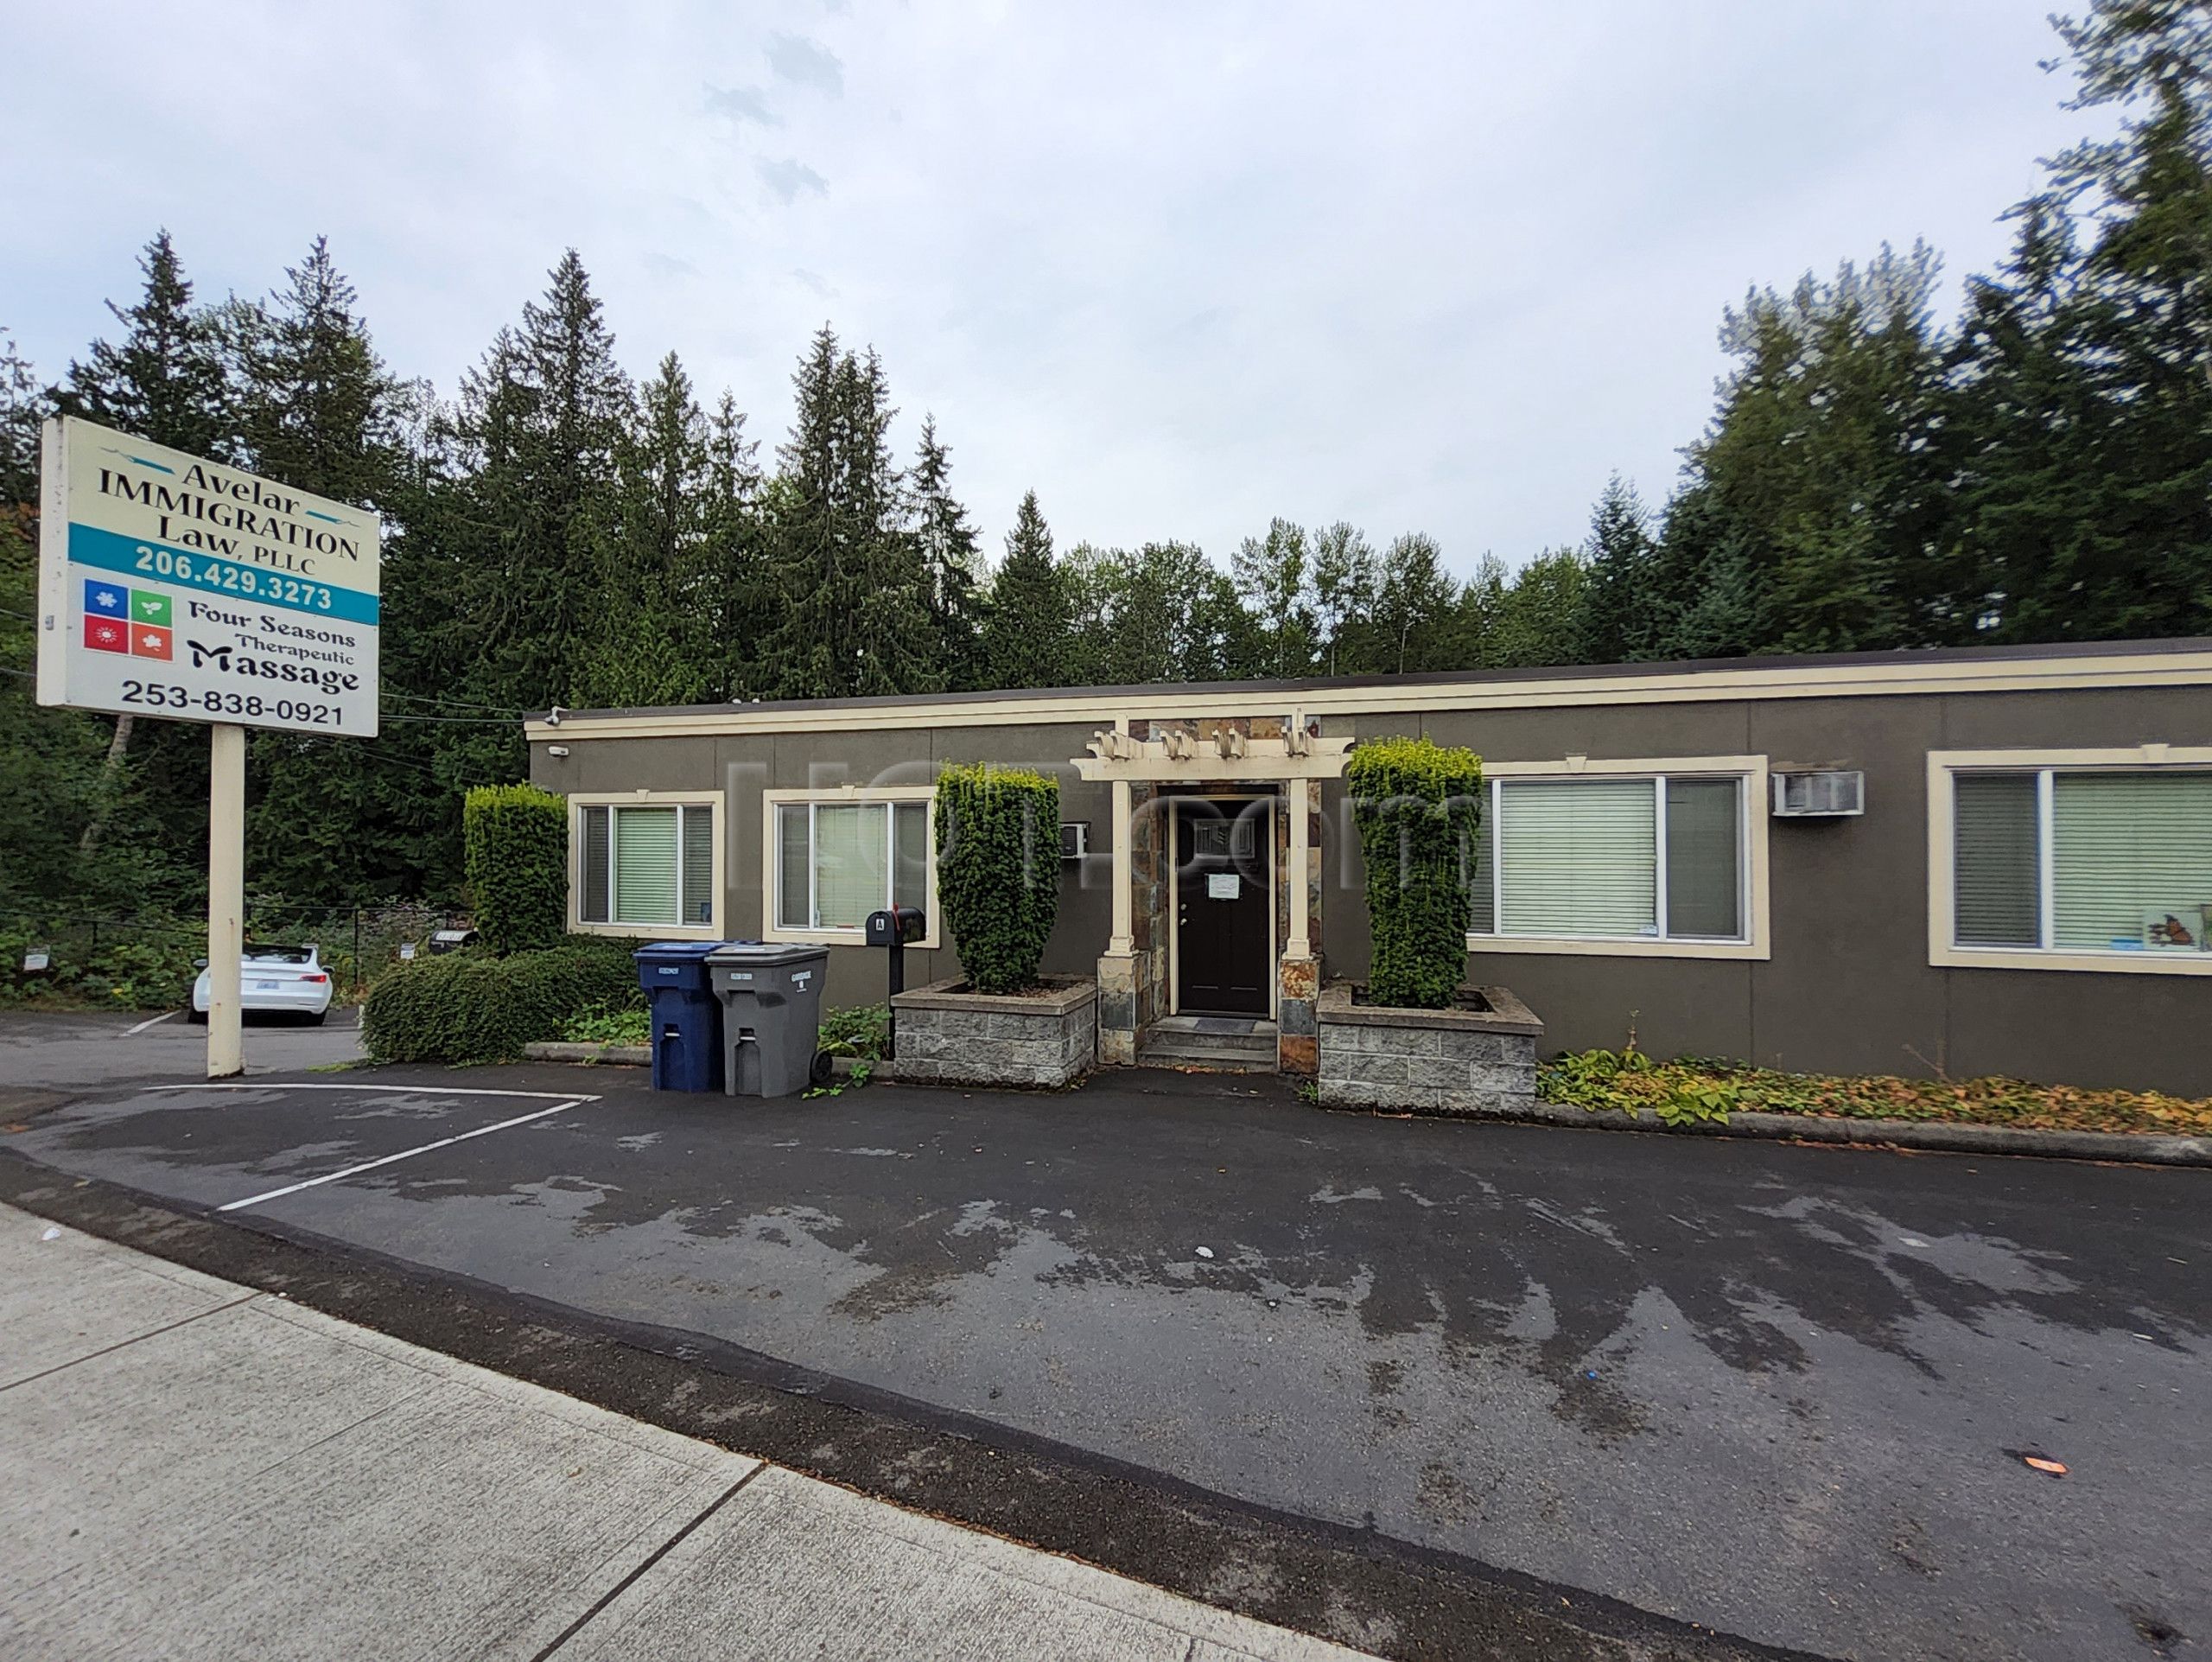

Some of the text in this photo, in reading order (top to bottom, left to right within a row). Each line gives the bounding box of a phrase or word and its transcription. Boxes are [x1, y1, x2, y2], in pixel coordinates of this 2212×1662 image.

[99, 468, 359, 562] IMMIGRATION
[182, 464, 300, 515] Avelar
[158, 514, 316, 576] Law, PLLC
[136, 545, 332, 609] 206.429.3273
[188, 600, 356, 647] Four Seasons
[235, 633, 354, 665] Therapeutic
[187, 640, 359, 695] Massage
[122, 680, 342, 726] 253-838-0921
